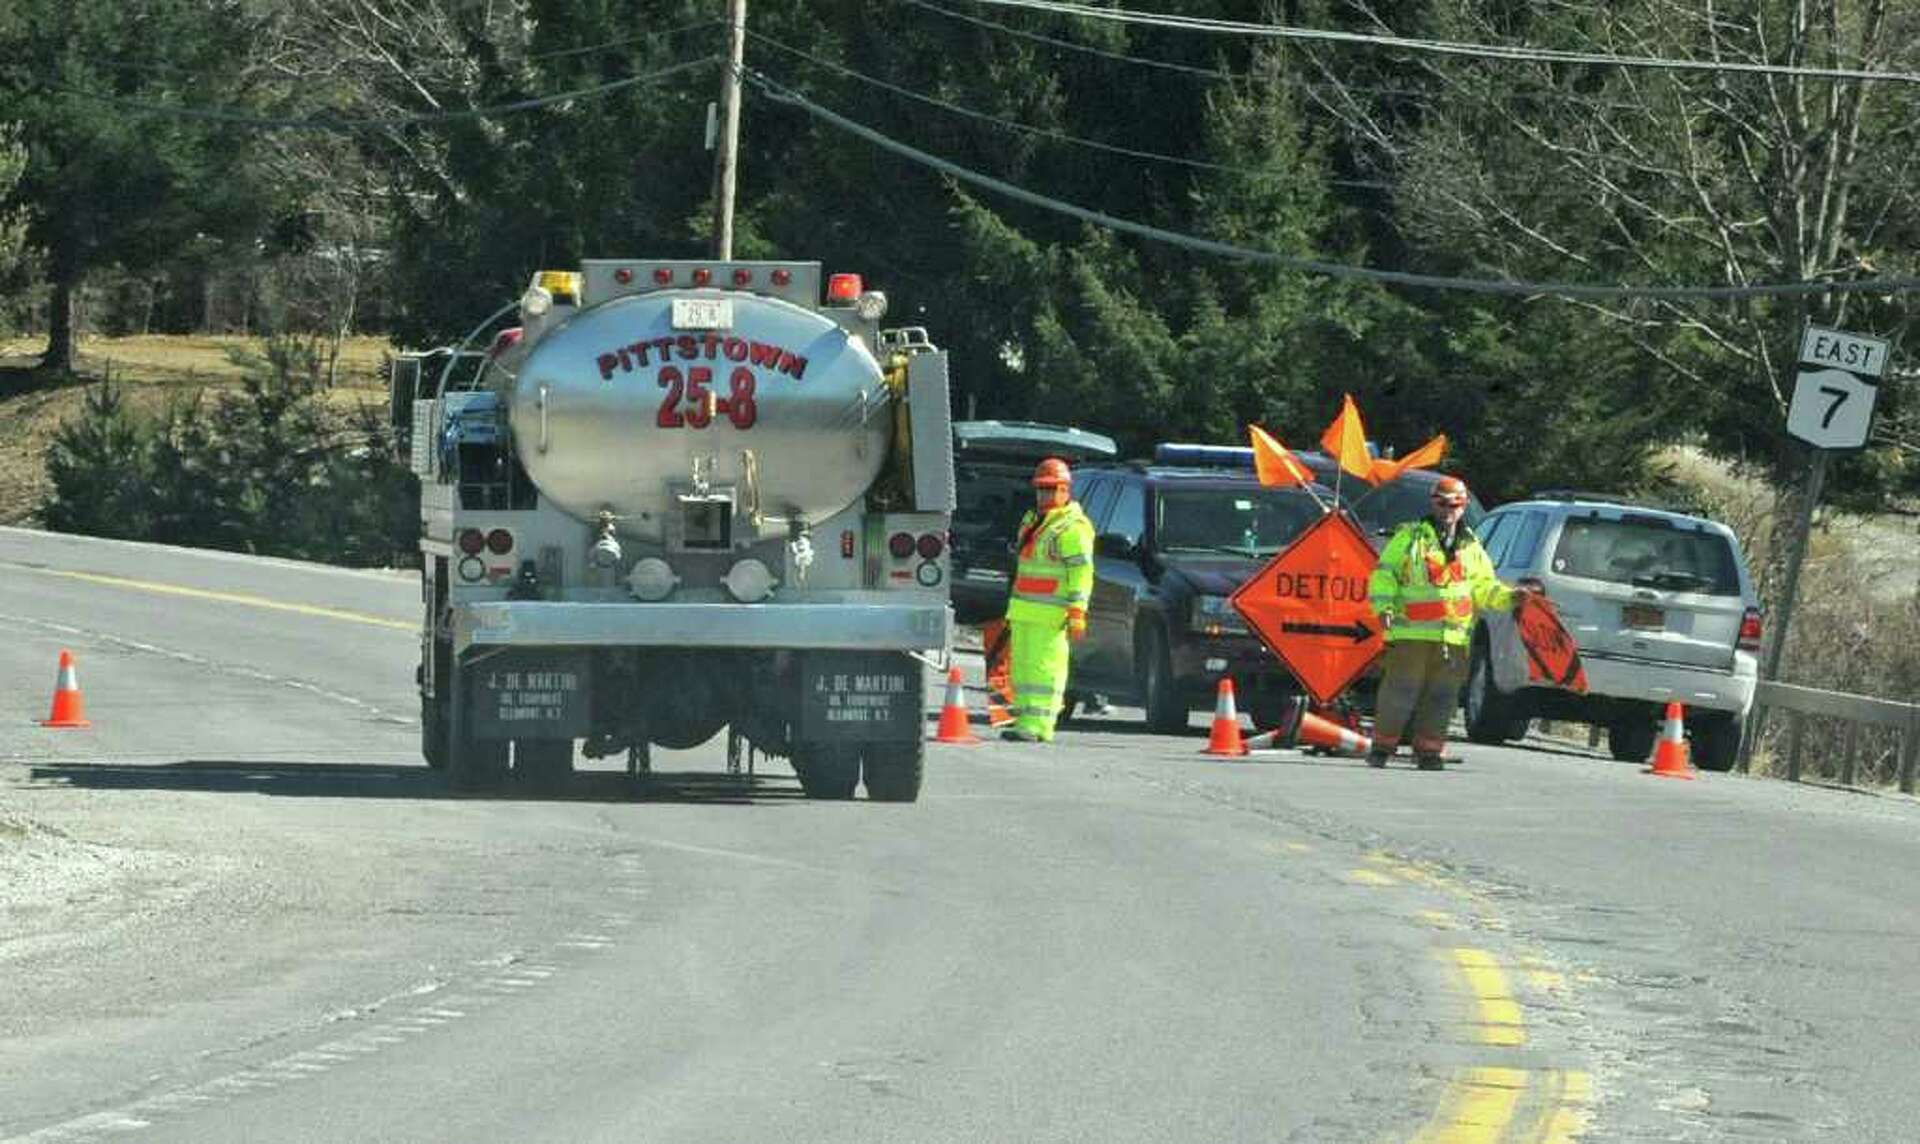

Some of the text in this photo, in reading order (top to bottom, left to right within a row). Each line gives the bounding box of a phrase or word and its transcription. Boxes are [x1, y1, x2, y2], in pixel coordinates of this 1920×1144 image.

[597, 333, 809, 381] PITTSTOWN
[1814, 336, 1875, 367] EAST
[656, 365, 758, 430] 25-8
[1819, 386, 1850, 429] 7
[1276, 571, 1368, 603] DETOU
